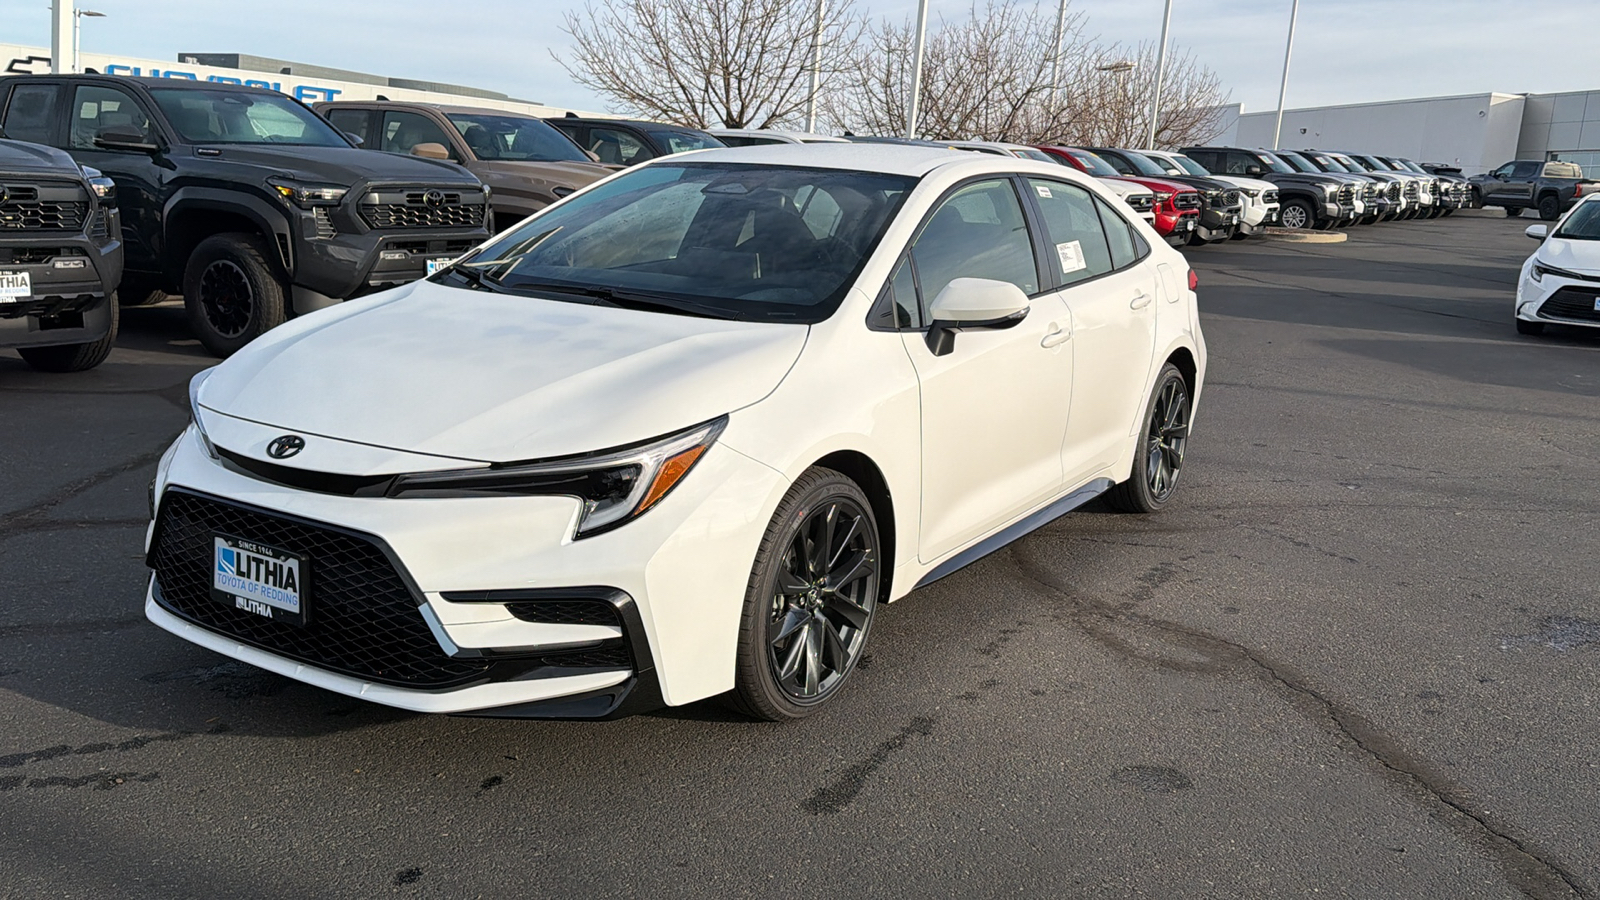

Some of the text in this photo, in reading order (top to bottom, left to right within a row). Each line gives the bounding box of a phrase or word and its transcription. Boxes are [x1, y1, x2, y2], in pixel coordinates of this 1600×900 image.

[238, 540, 273, 557] SINCE 1946
[236, 552, 297, 593] LITHIA
[217, 573, 298, 606] TOYOTA OF REDDING
[243, 598, 273, 619] LITHIA
